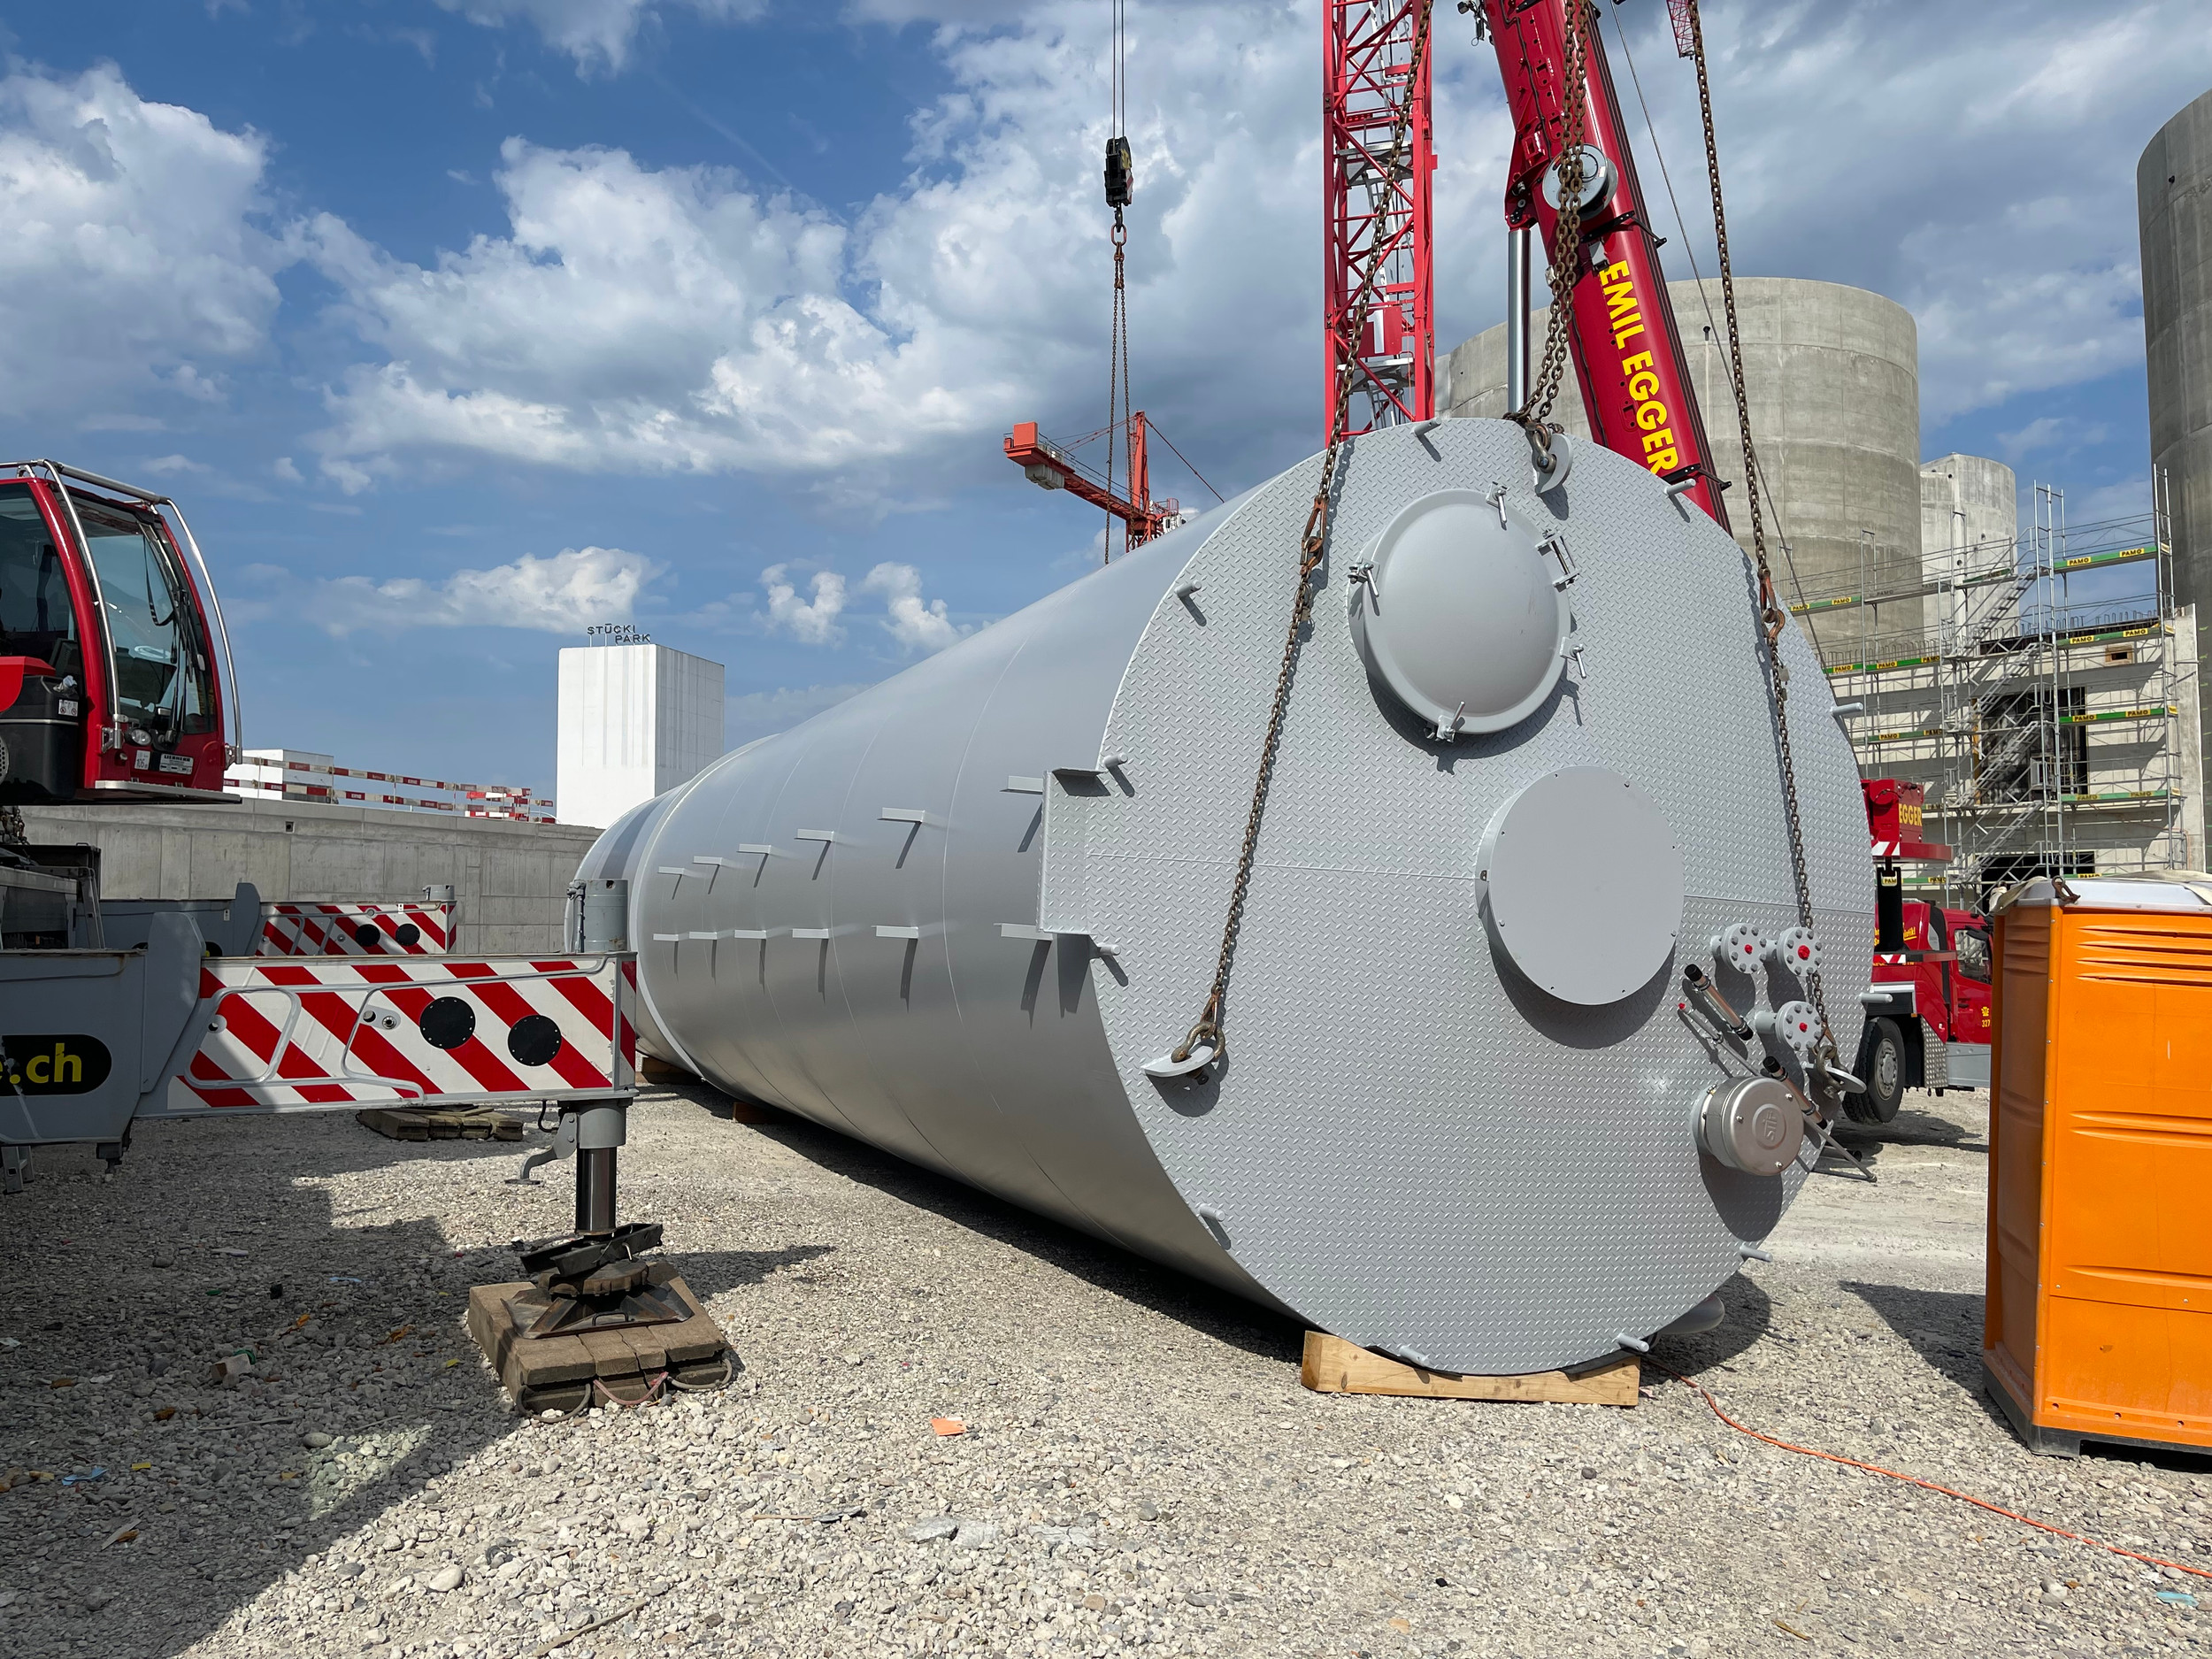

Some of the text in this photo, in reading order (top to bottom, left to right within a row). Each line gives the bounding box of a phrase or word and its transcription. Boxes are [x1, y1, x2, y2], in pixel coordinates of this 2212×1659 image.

[1366, 310, 1385, 354] 1
[1599, 260, 1679, 474] EMIL EGGER
[2121, 549, 2142, 557] PAMO
[615, 634, 650, 644] PARK
[1899, 803, 1923, 826] EGGER
[0, 1042, 82, 1084] .ch
